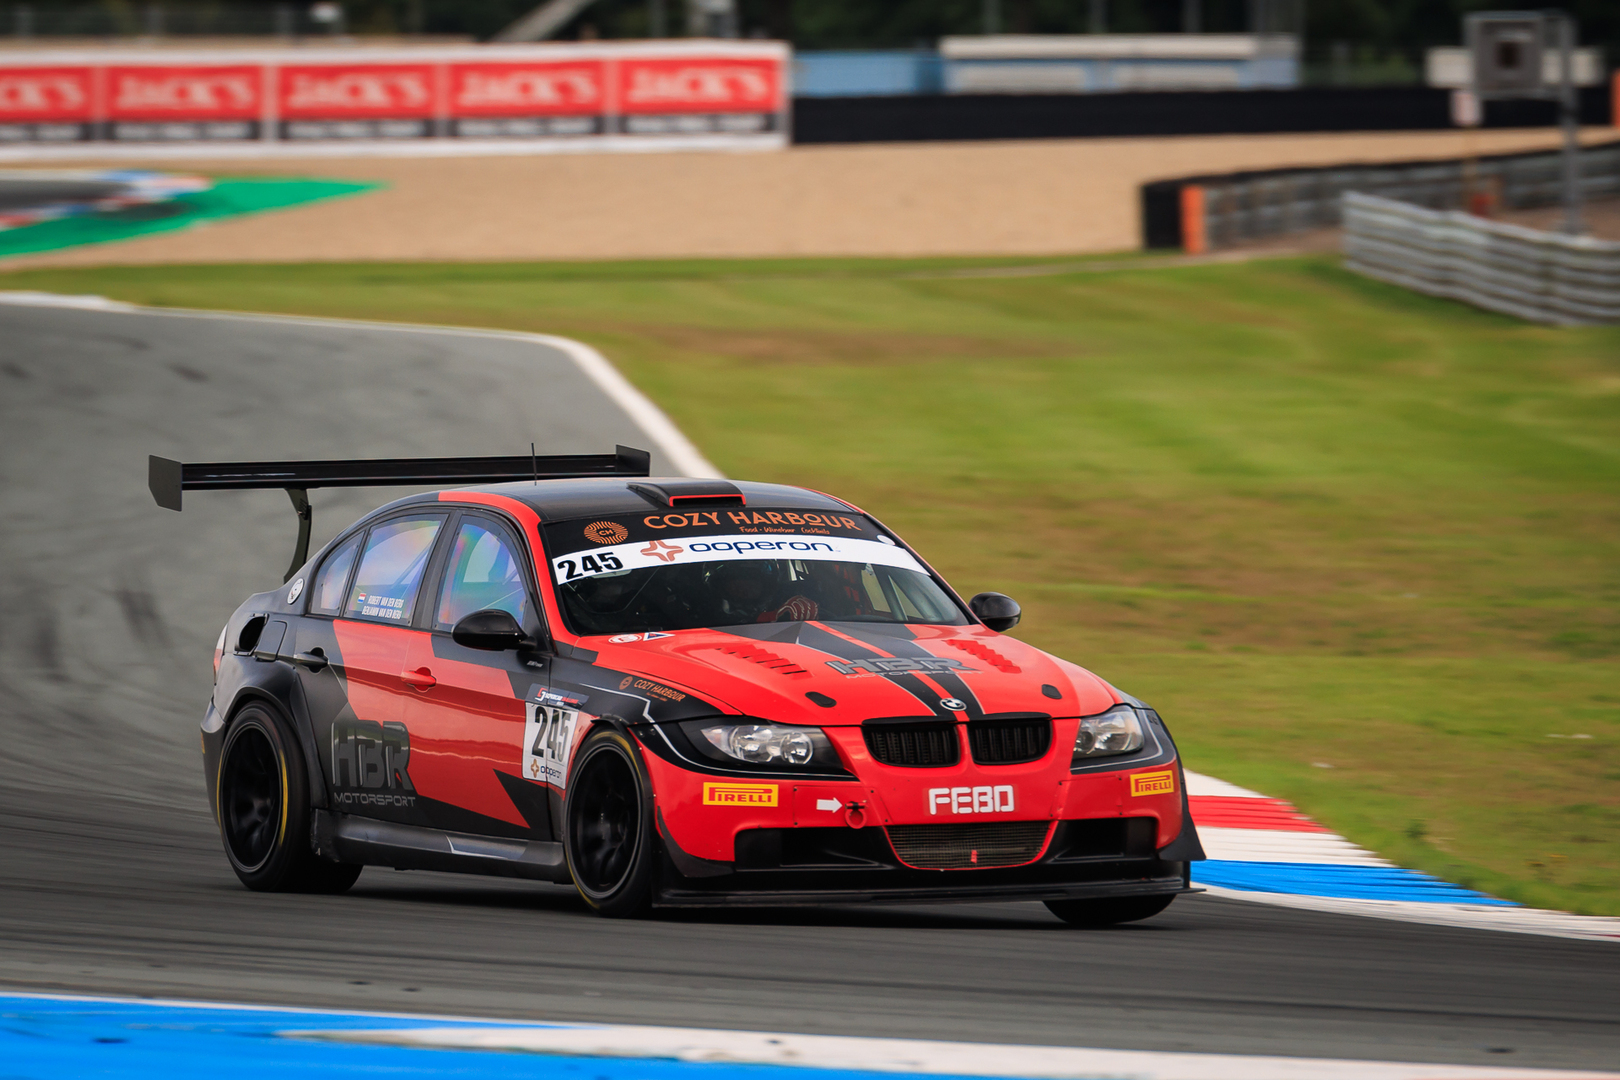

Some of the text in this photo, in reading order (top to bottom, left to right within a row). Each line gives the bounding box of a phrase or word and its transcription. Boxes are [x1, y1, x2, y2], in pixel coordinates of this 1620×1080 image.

[643, 511, 863, 532] COZY HARBOUR
[557, 551, 624, 580] 245
[823, 657, 982, 676] HBR
[633, 679, 656, 691] COZY
[650, 684, 687, 702] HARBOUR
[531, 705, 572, 762] 245
[331, 720, 415, 791] HBR
[1134, 774, 1172, 793] PIRELLI
[333, 791, 416, 807] MOTORSPORT
[708, 786, 773, 803] PIRELLI
